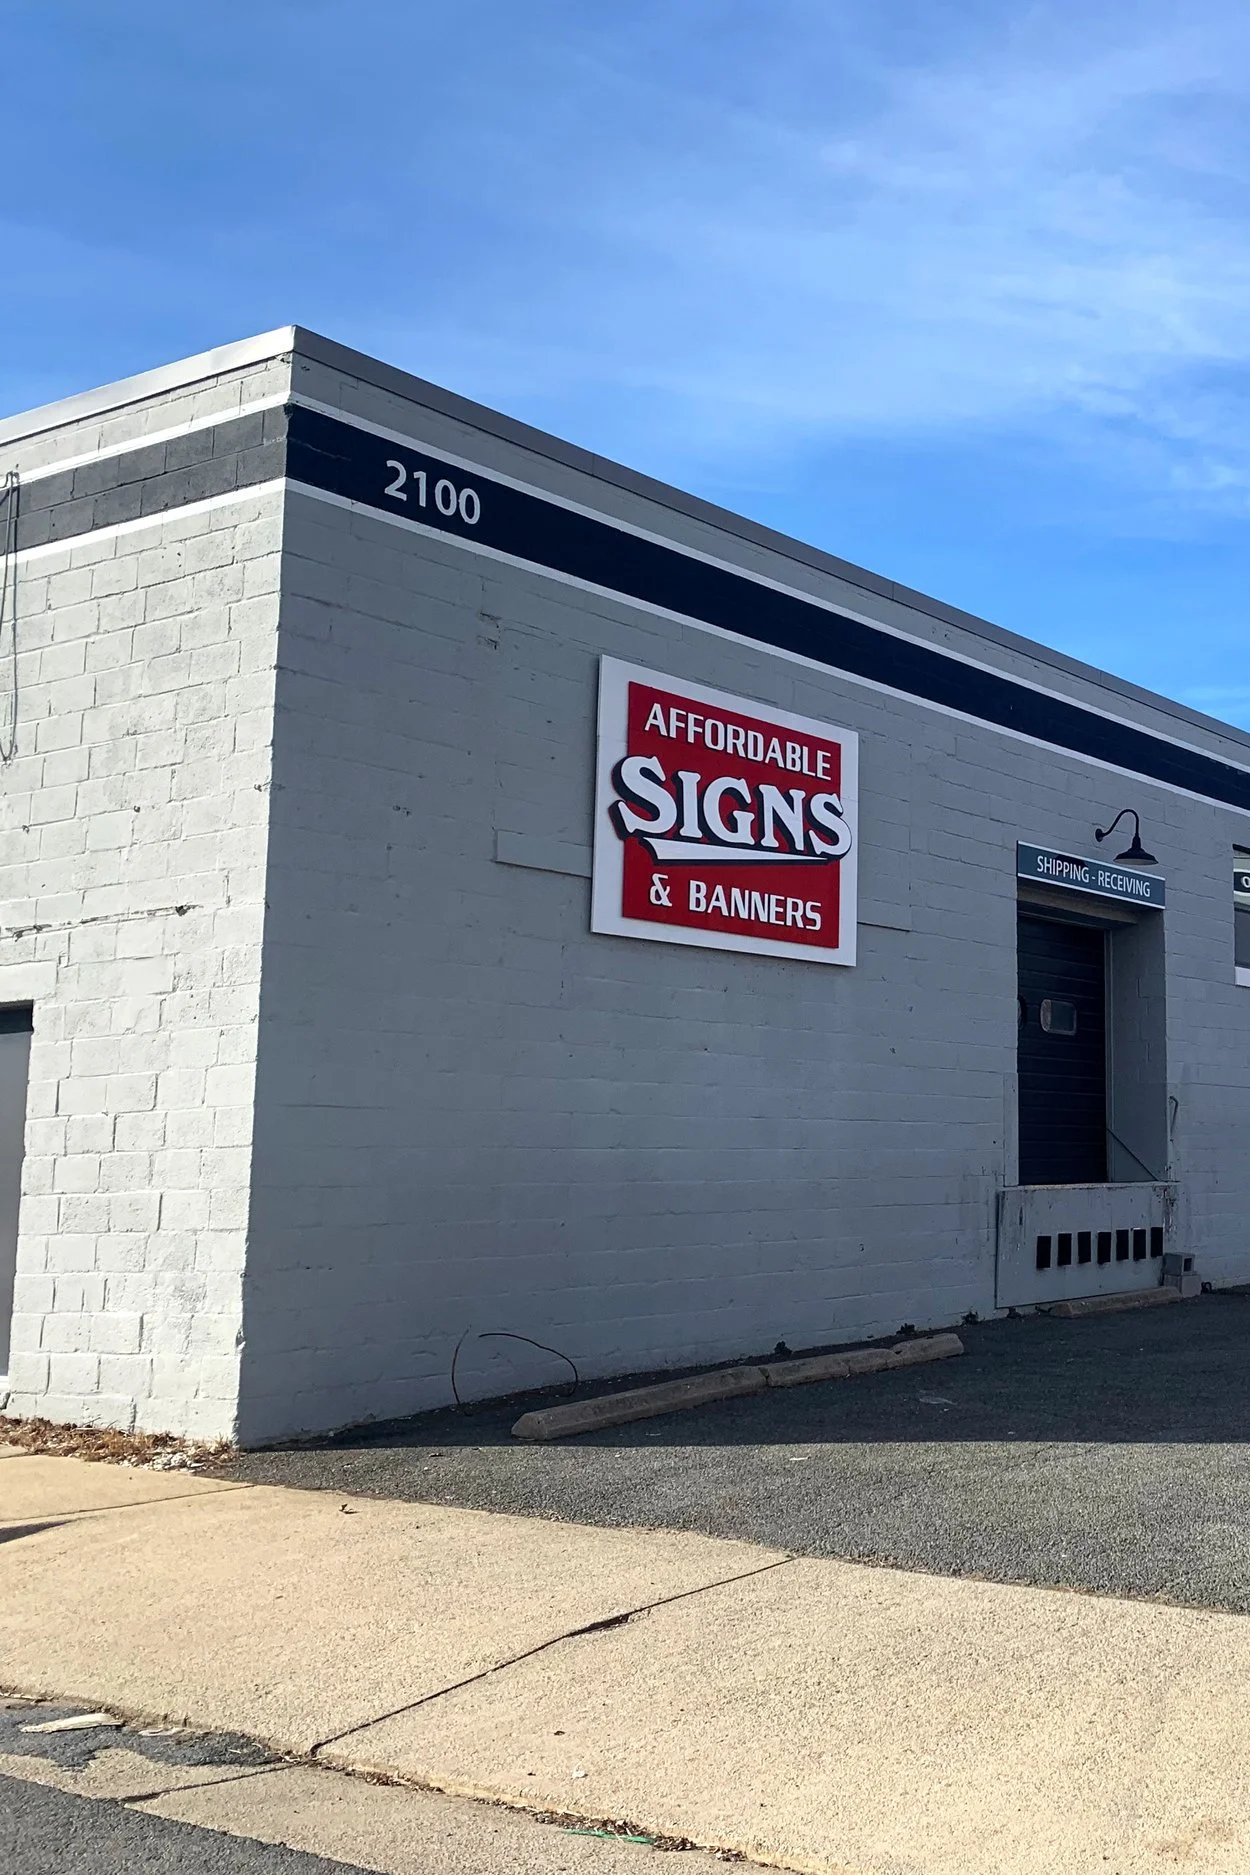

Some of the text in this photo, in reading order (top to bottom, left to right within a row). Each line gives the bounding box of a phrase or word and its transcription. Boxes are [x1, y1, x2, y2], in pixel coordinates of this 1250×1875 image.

[384, 459, 481, 525] 2100
[644, 702, 832, 781] AFFORDABLE
[612, 754, 853, 858] SIGNS
[649, 873, 822, 931] & BANNERS
[1037, 855, 1090, 883] SHIPPING
[1097, 870, 1151, 898] RECEIVING
